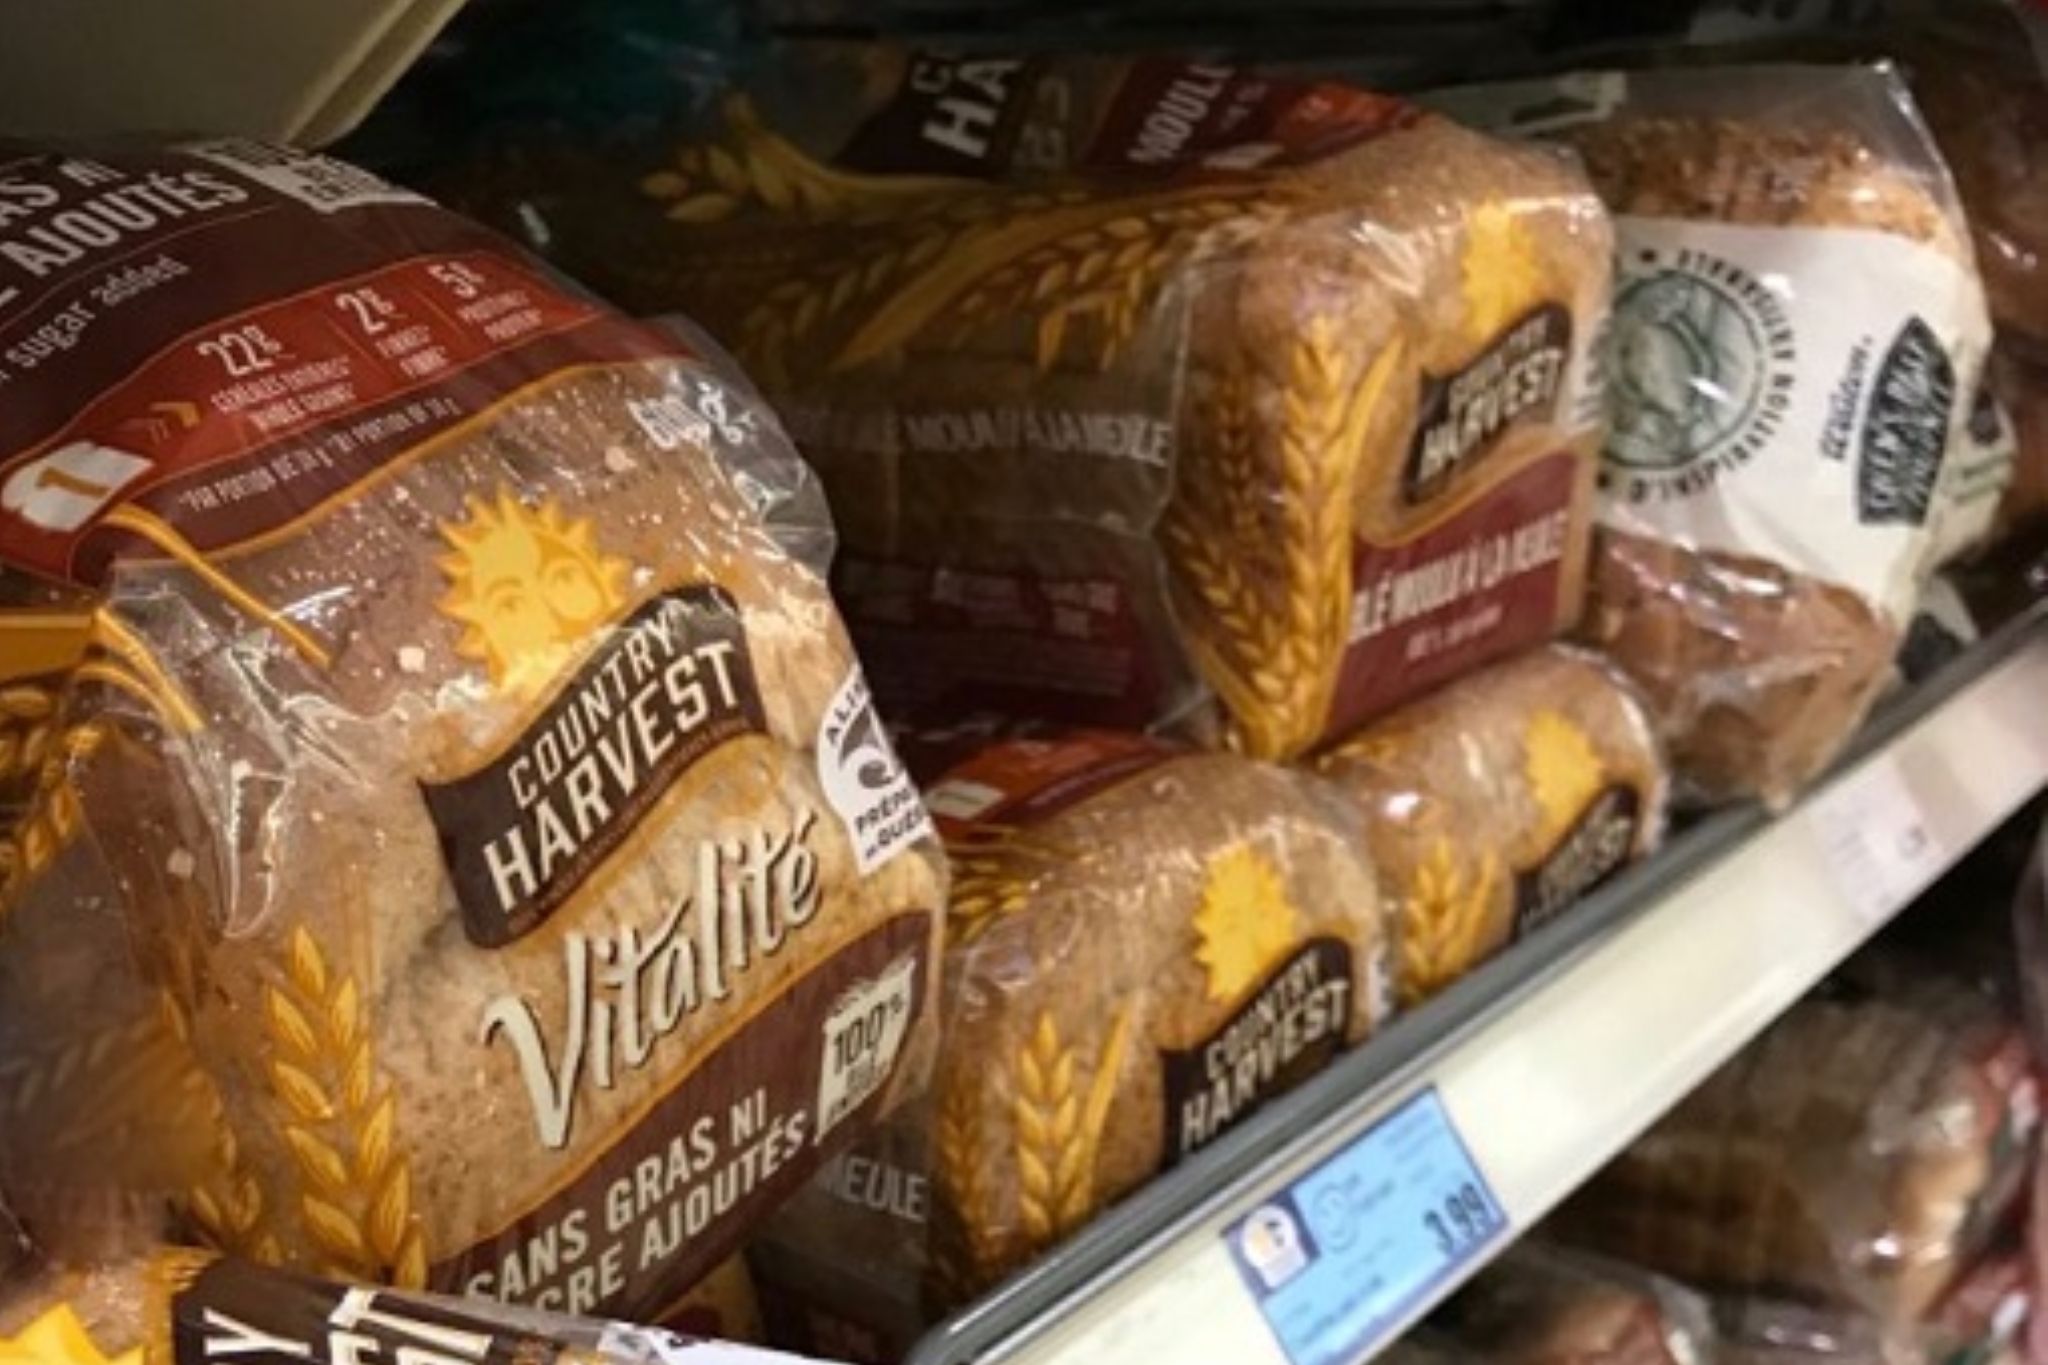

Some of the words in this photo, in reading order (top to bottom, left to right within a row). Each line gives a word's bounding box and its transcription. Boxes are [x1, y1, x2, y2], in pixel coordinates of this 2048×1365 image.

[1127, 64, 1235, 163] MOUL
[0, 172, 249, 276] AJOUTÉS
[5, 300, 96, 368] sugar
[90, 253, 190, 306] added
[481, 640, 738, 912] HARVEST
[507, 610, 676, 812] COUNTRY
[477, 803, 822, 1150] Vitalité
[1180, 977, 1350, 1153] HARVEST
[465, 1208, 592, 1303] SANS
[604, 1115, 717, 1234] GRAS
[728, 1087, 769, 1140] NI
[533, 1240, 624, 1317] CRE
[638, 1108, 808, 1272] AJOUTÉS
